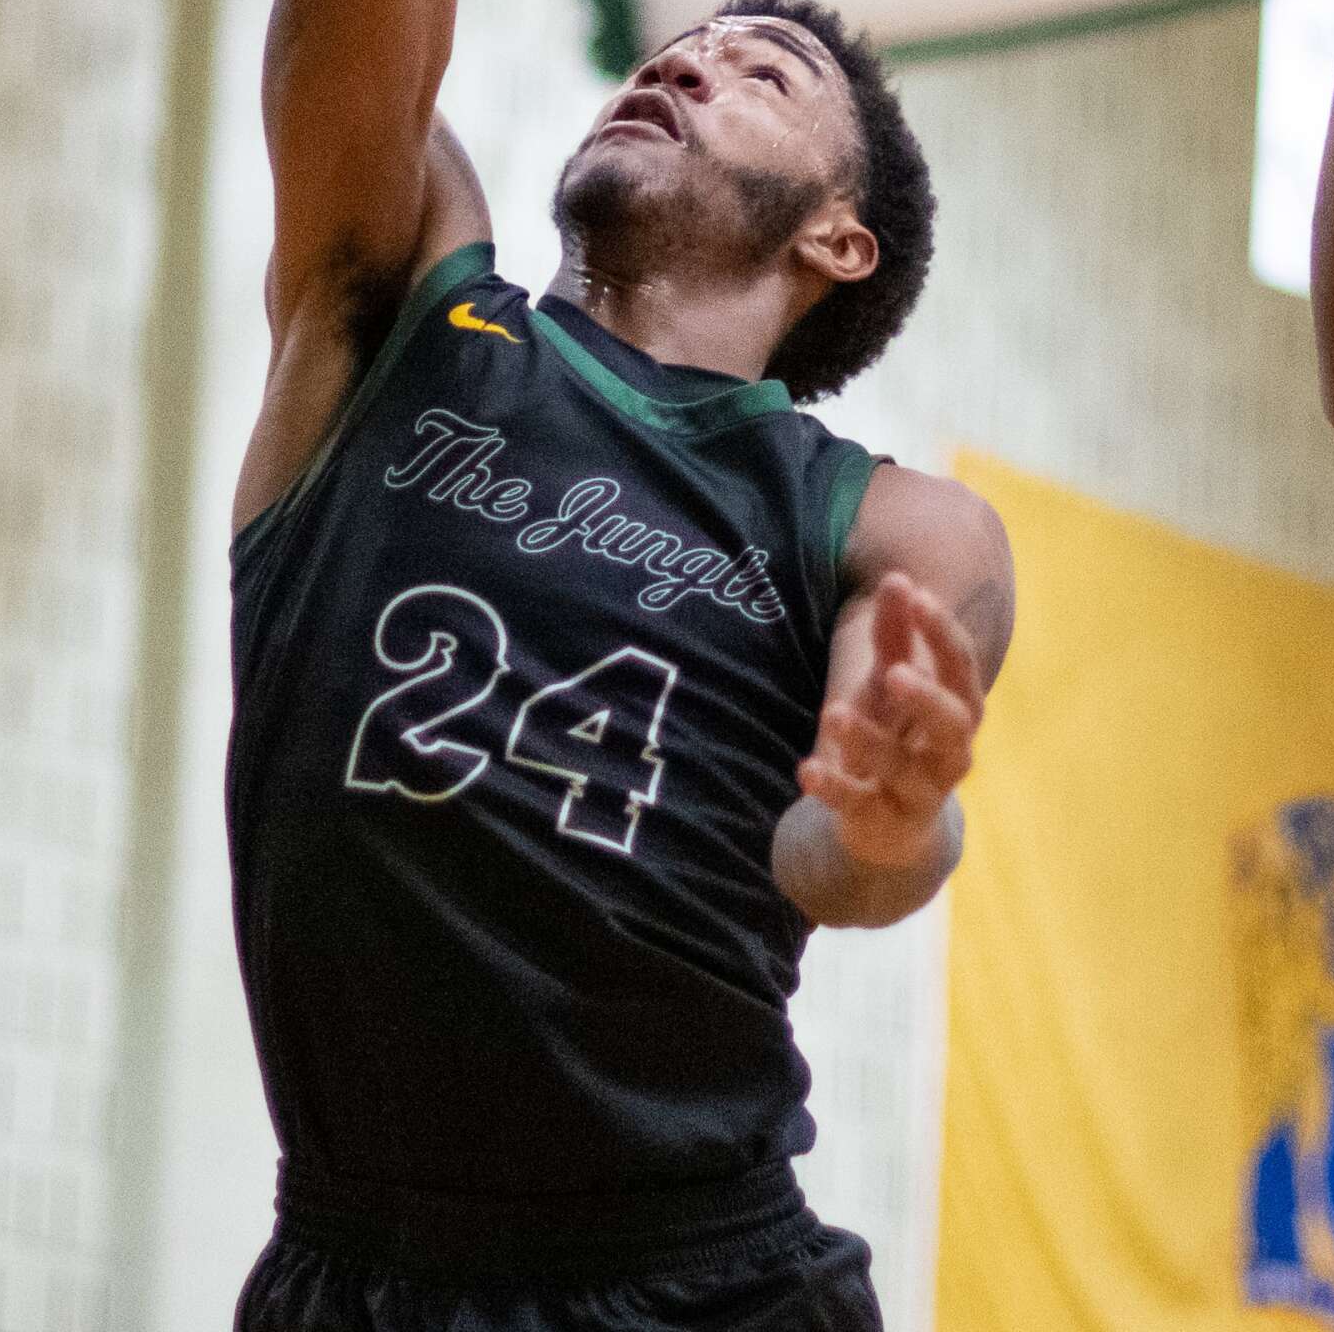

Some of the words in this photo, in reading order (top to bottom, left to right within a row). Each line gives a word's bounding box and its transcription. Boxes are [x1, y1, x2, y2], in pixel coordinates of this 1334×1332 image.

[385, 407, 532, 522] The
[516, 476, 786, 624] Jungle
[344, 583, 678, 854] 24
